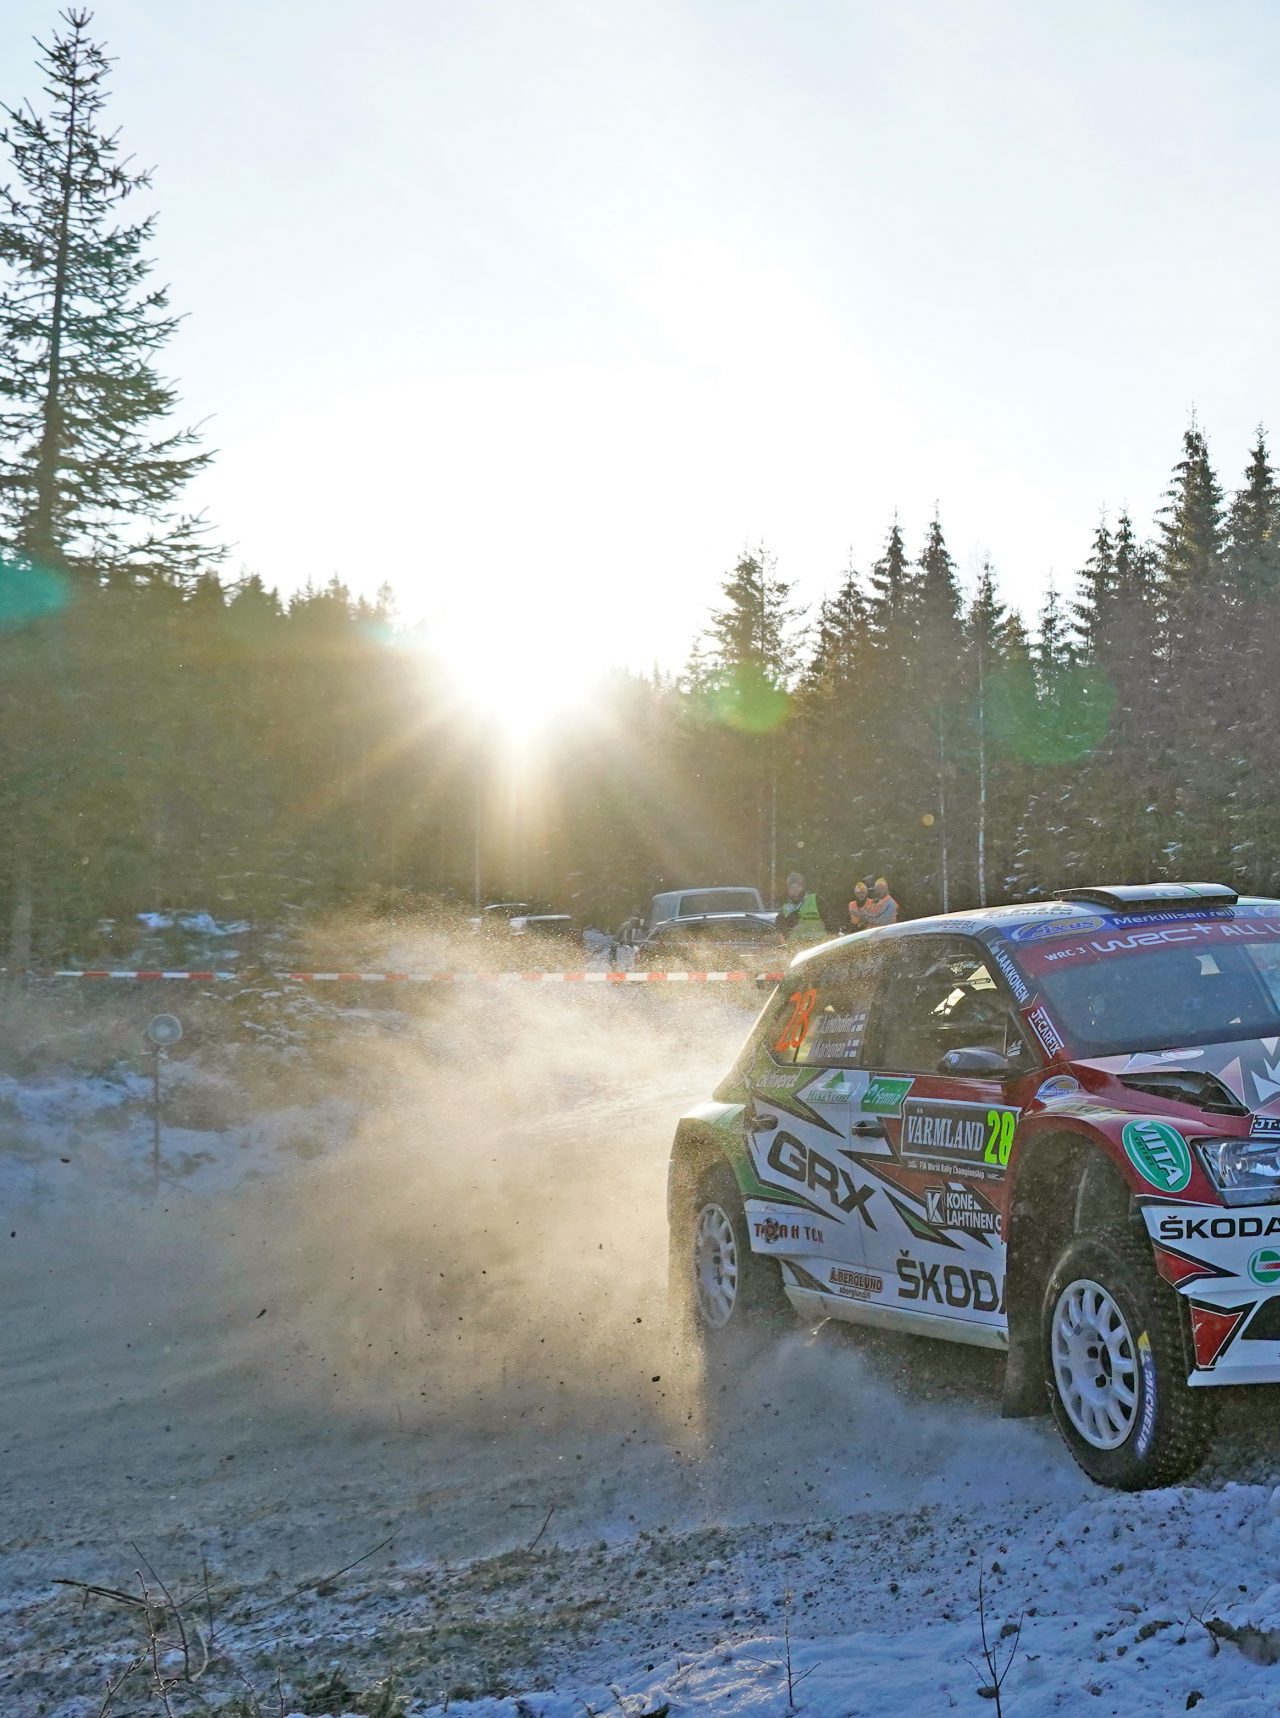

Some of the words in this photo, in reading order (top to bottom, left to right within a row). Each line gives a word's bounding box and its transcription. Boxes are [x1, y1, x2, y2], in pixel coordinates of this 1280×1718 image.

[1112, 907, 1208, 925] Merkillisen
[1044, 949, 1076, 961] WRC
[1076, 946, 1087, 954] 3
[1218, 925, 1266, 937] ALL
[995, 949, 1030, 1003] LAAKKONEN
[907, 1107, 985, 1152] VÄRMLAND
[984, 1110, 1015, 1166] 28
[1133, 1120, 1184, 1187] VIITA
[767, 1130, 878, 1232] GRX
[919, 1161, 928, 1170] FIA
[927, 1163, 940, 1172] World
[940, 1164, 952, 1175] Rally
[953, 1165, 985, 1180] Championship
[946, 1192, 973, 1211] KONE
[946, 1209, 994, 1230] LAHTINEN
[1138, 1367, 1154, 1453] MICHELIN
